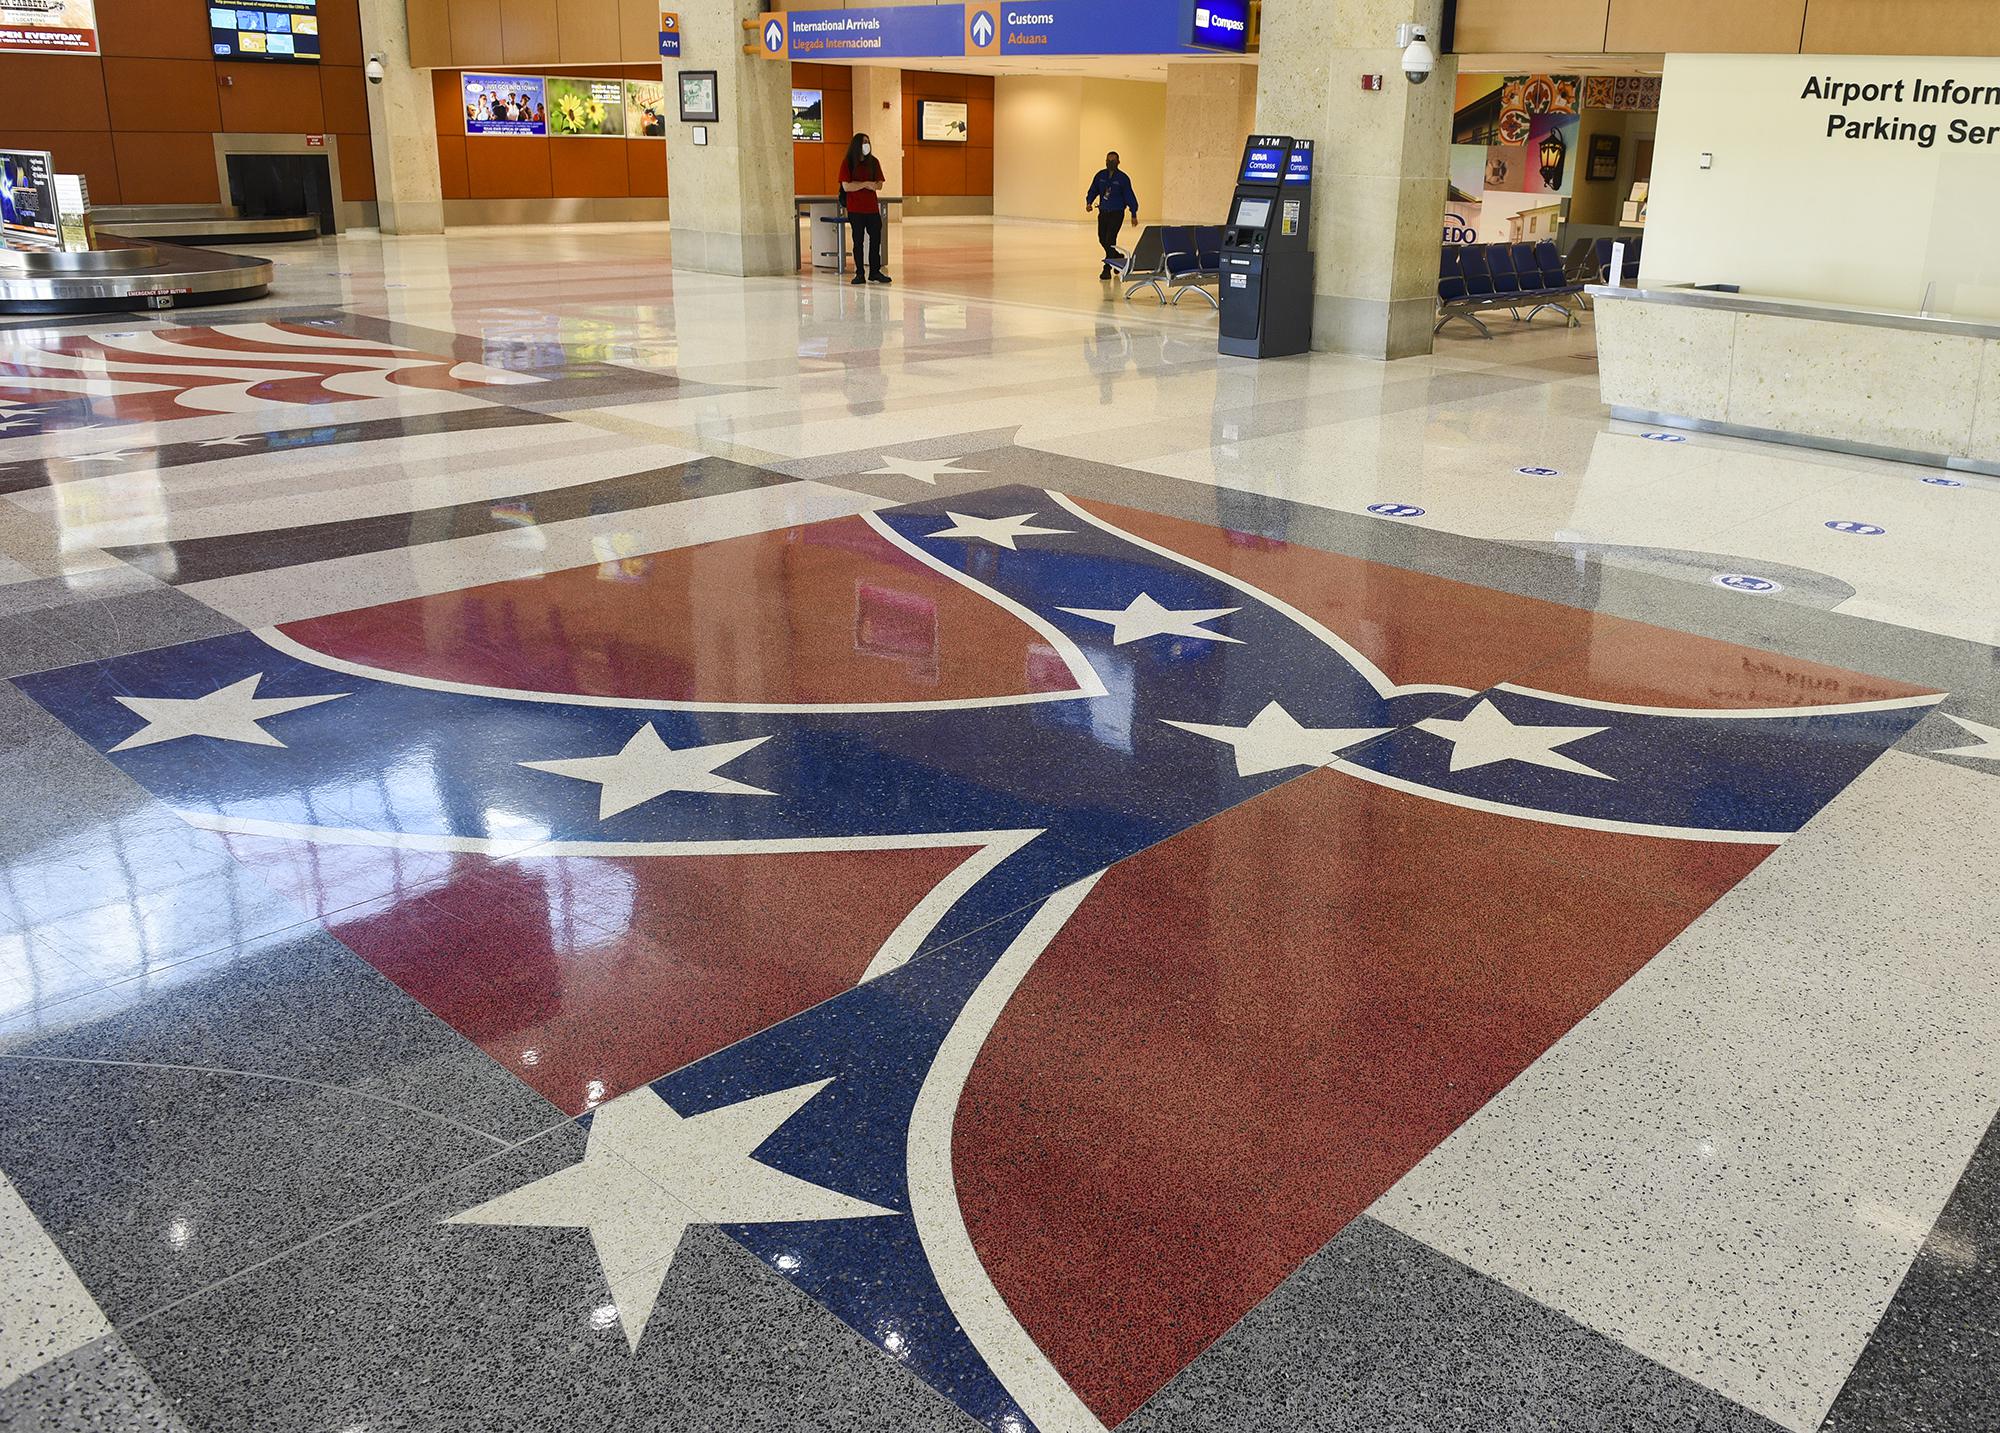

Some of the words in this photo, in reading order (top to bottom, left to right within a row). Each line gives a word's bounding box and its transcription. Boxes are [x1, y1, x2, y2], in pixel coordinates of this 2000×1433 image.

[1008, 12, 1054, 25] Customs
[1211, 14, 1244, 31] Compass
[793, 19, 845, 32] International
[846, 18, 880, 30] Arrivals
[24, 31, 82, 41] EVERYDAY
[1008, 32, 1047, 45] Aduana
[662, 40, 678, 48] ATM
[793, 38, 824, 52] Llegada
[826, 36, 881, 49] Internacional
[1800, 76, 1905, 106] Airport
[1826, 114, 1937, 148] Parking
[1947, 119, 2000, 145] Ser
[1258, 137, 1281, 146] ATM
[1295, 140, 1310, 149] ATM
[1251, 153, 1268, 161] BBVA
[1249, 161, 1276, 170] Compass
[1290, 163, 1309, 171] Compass
